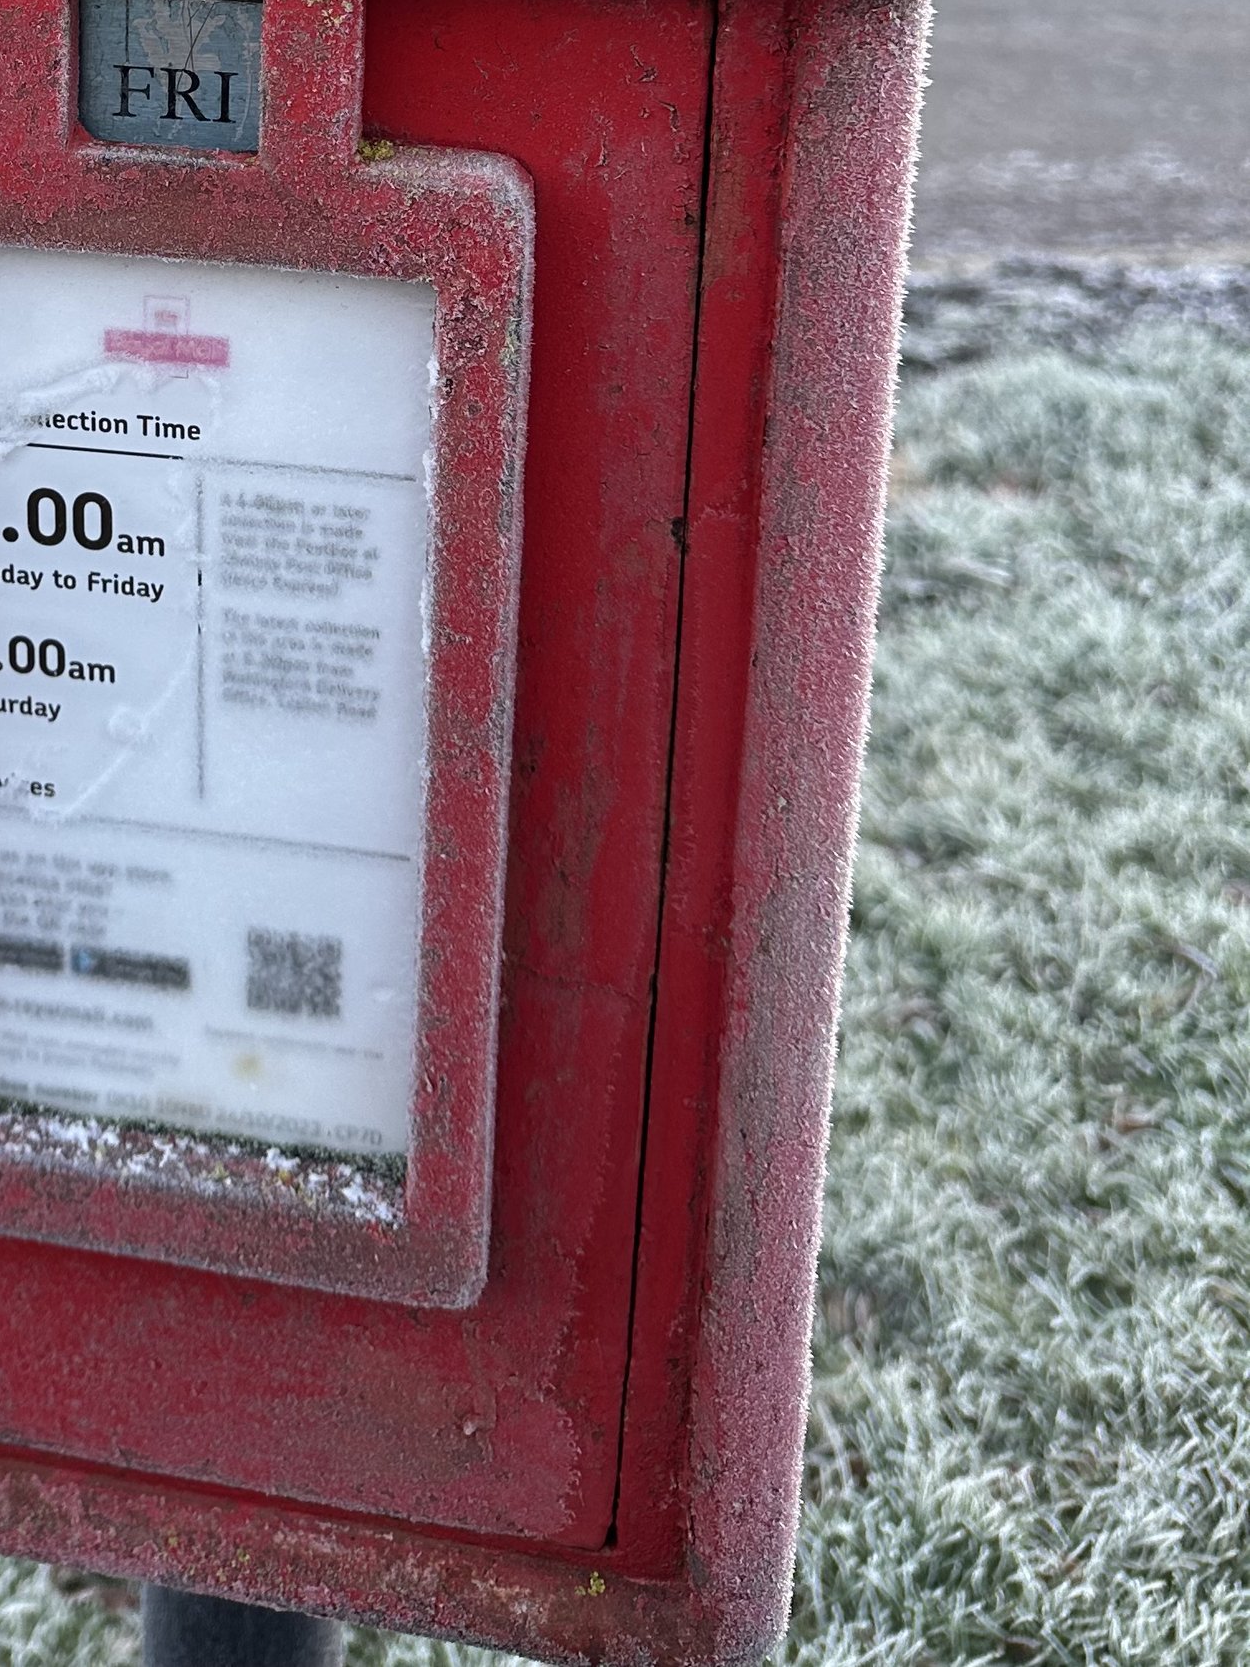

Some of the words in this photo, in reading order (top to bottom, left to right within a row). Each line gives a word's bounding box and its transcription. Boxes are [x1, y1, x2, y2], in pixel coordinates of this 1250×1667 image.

[112, 63, 238, 124] FRI
[6, 404, 128, 435] lection
[136, 414, 201, 441] Time
[53, 569, 77, 590] to
[87, 571, 165, 603] Friday
